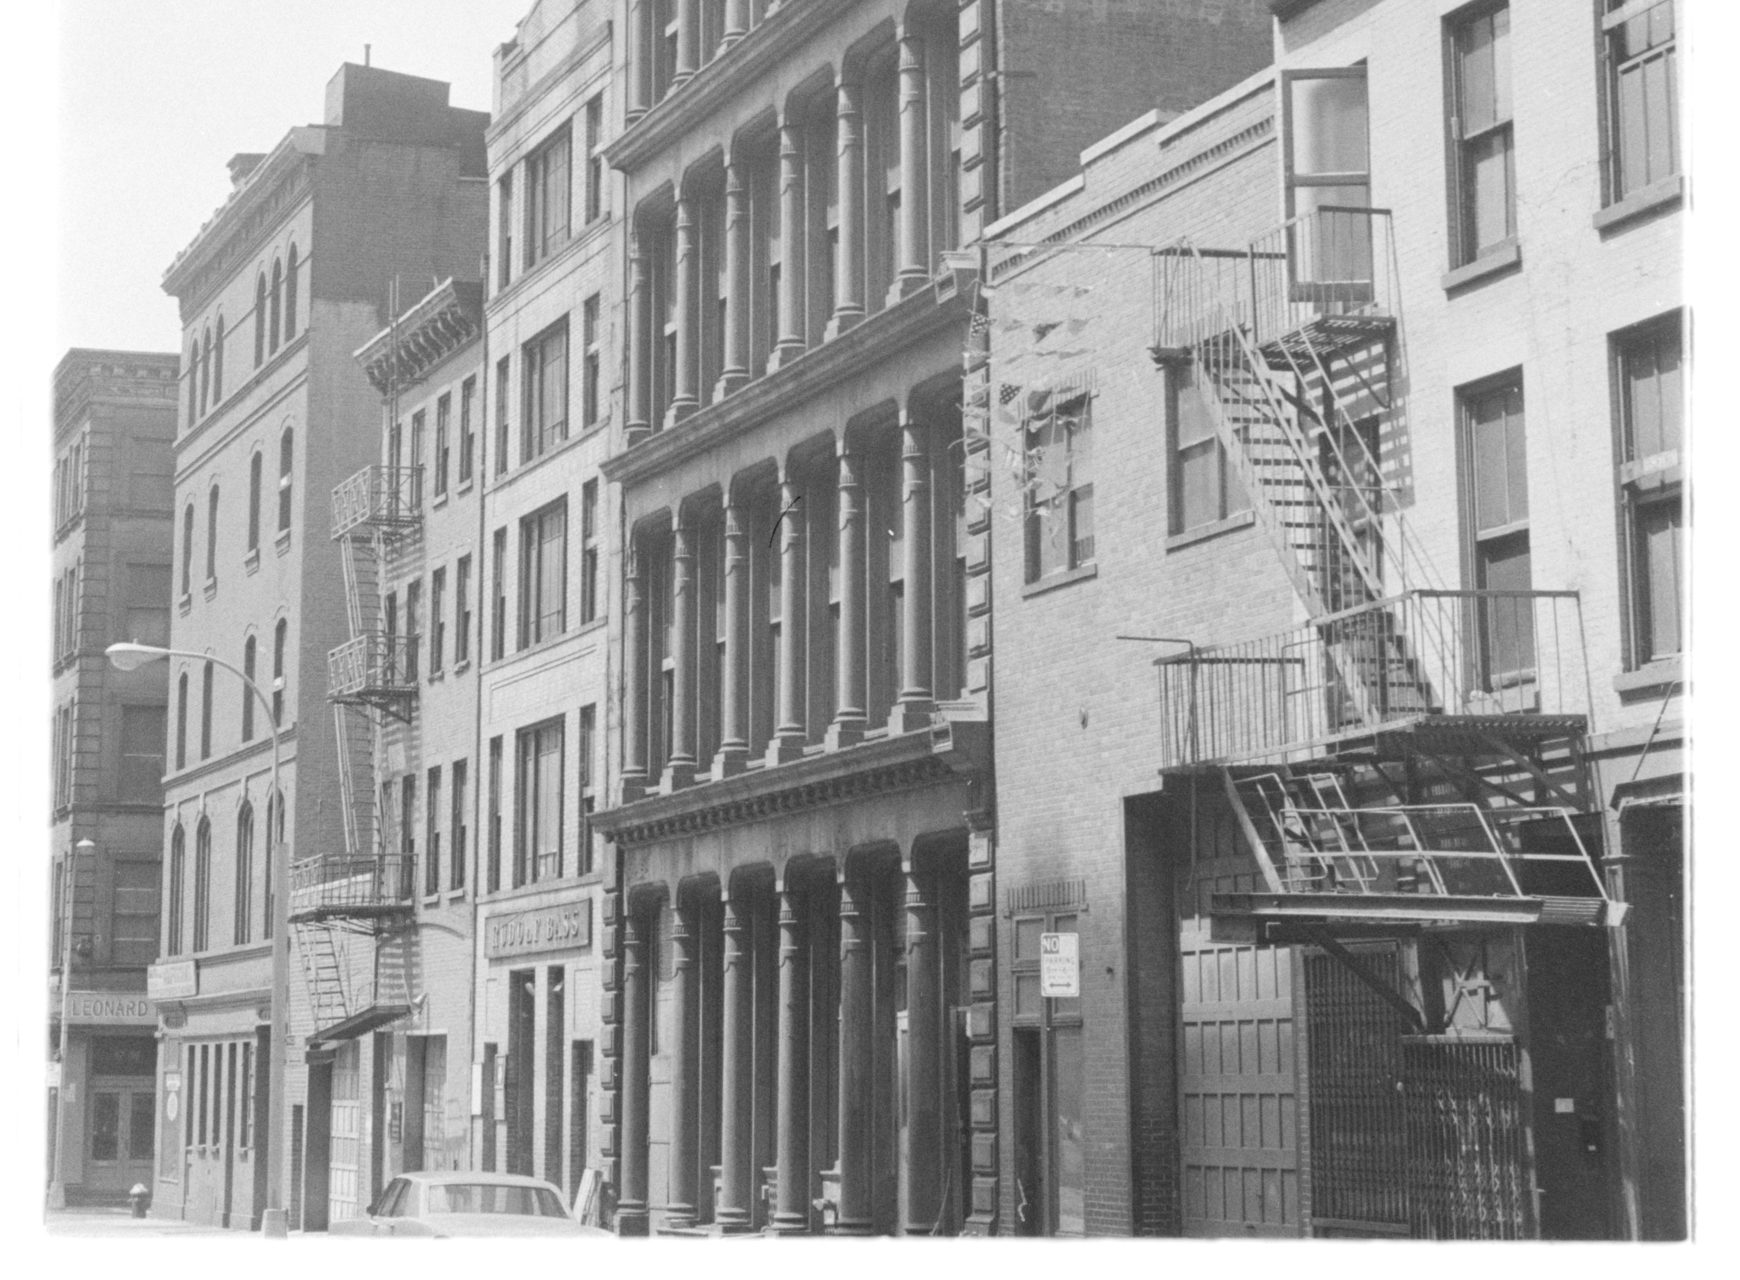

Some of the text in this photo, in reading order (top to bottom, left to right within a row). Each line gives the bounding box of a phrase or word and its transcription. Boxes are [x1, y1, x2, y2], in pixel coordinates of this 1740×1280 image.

[546, 910, 580, 941] BASS
[1043, 937, 1059, 952] NO
[72, 1000, 148, 1017] LEONARD
